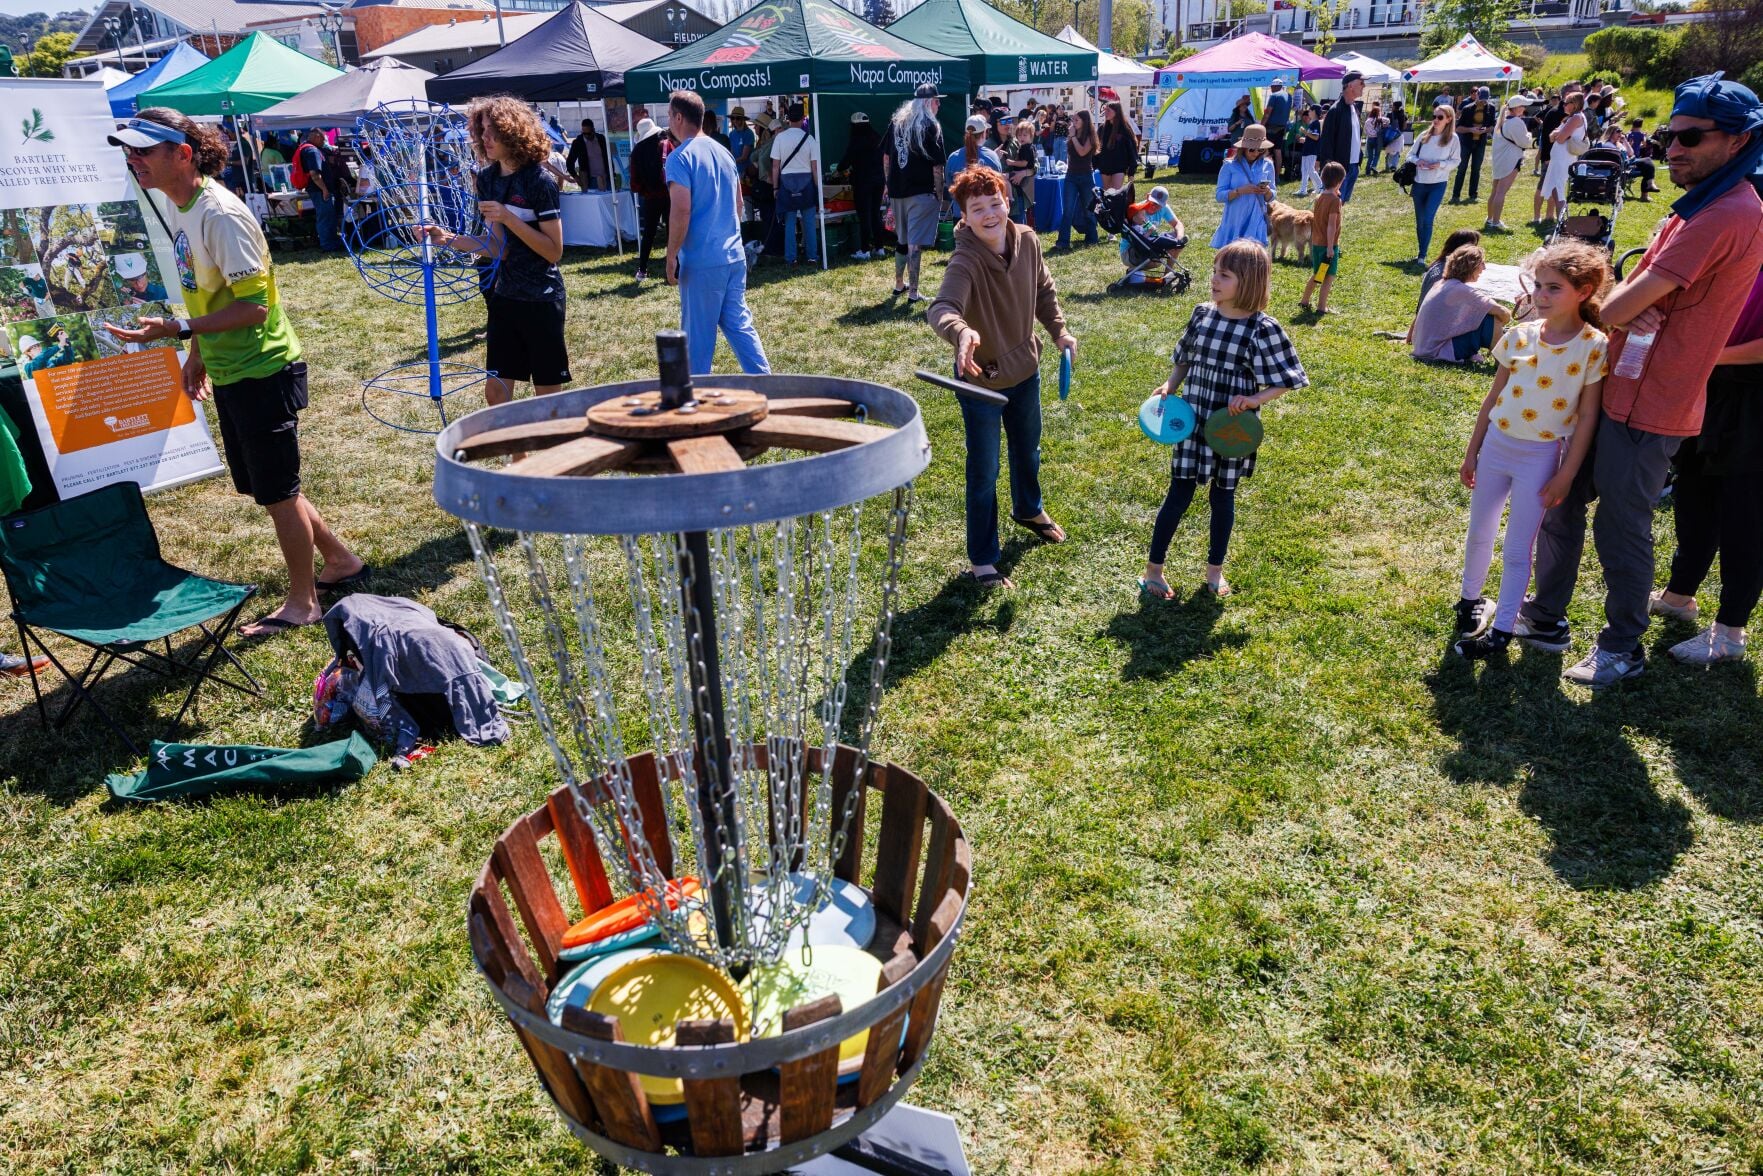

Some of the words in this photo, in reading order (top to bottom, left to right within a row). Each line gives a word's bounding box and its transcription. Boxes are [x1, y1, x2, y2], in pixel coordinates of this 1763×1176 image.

[674, 32, 708, 42] FIELDW
[1030, 61, 1069, 75] WATER
[659, 73, 697, 92] Napa
[700, 66, 771, 93] Composts!
[850, 63, 884, 89] Napa
[888, 63, 942, 89] Composts!
[1178, 115, 1231, 126] byebyemattr
[14, 154, 69, 164] BARTLETT.
[0, 166, 41, 176] SCOVER
[42, 164, 66, 174] WHY
[68, 164, 97, 173] WE'RE
[0, 177, 30, 187] ALLED
[32, 176, 57, 185] TREE
[60, 174, 102, 184] EXPERTS.
[229, 266, 260, 277] SKYLIN
[63, 480, 83, 488] PLEASE
[106, 467, 129, 477] BARTLETT
[183, 749, 238, 768] MAC
